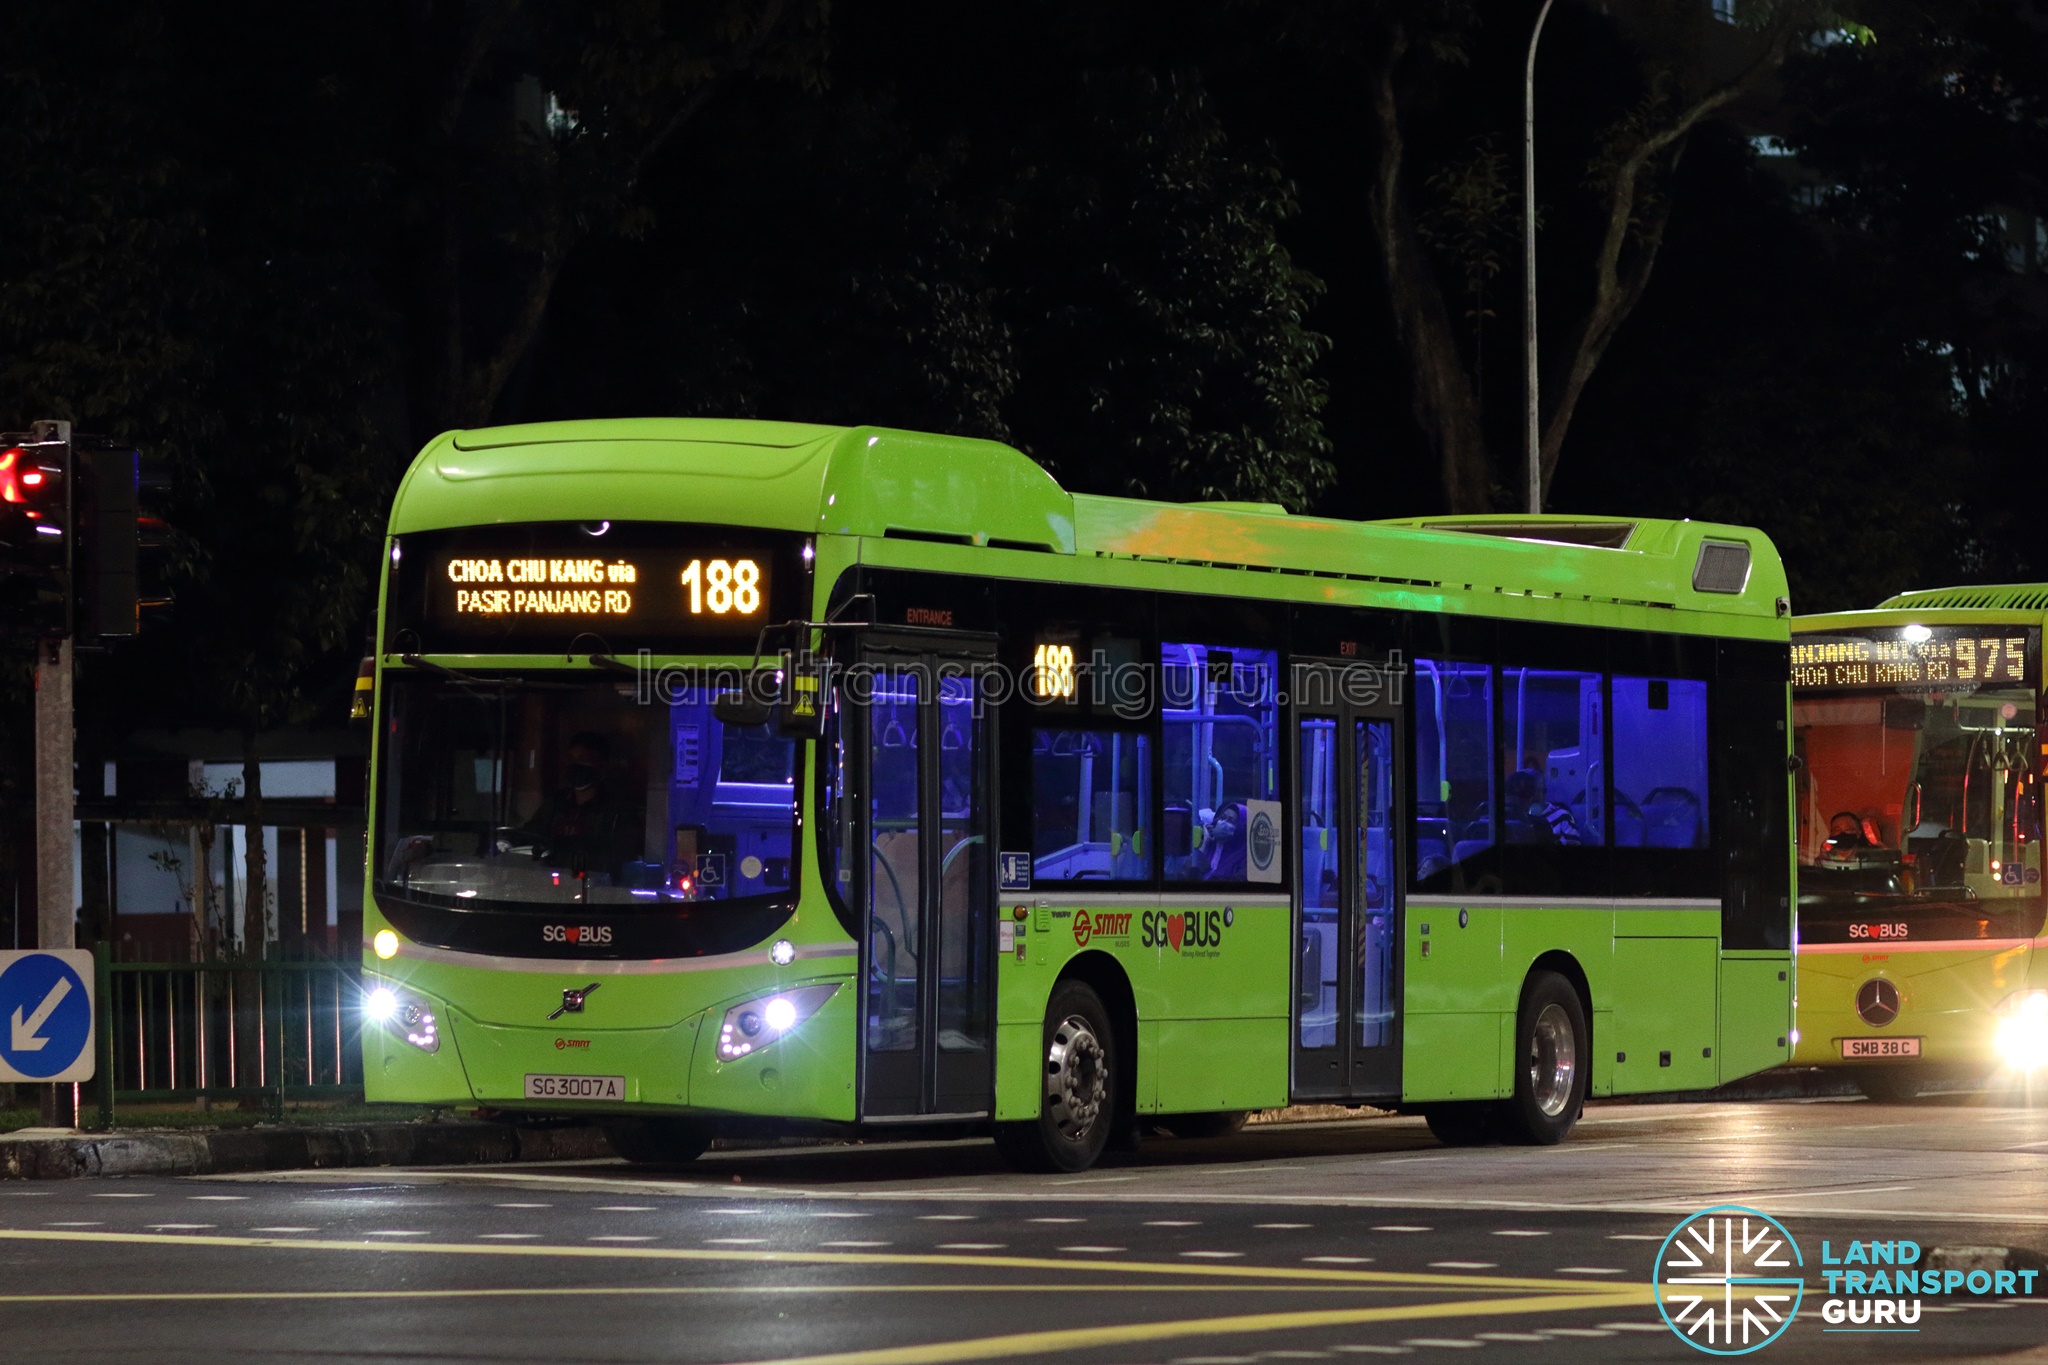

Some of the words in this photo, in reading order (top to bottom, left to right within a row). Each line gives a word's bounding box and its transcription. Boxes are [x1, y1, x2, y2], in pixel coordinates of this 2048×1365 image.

[448, 559, 503, 583] CHOA
[506, 559, 547, 583] CHU
[550, 559, 604, 583] KANG
[607, 559, 636, 583] via
[681, 559, 760, 614] 188
[457, 590, 511, 613] PASIR
[514, 590, 601, 613] PANJANG
[604, 590, 631, 613] RD
[907, 608, 952, 626] ENTRANCE
[1341, 641, 1357, 655] EXIT
[1956, 637, 2024, 680] 975
[1034, 644, 1074, 697] 188
[1791, 666, 1828, 686] HOA
[1835, 664, 1868, 684] CHU
[1875, 662, 1920, 683] KANG
[1927, 661, 1949, 680] RD
[1092, 913, 1132, 935] SMRT
